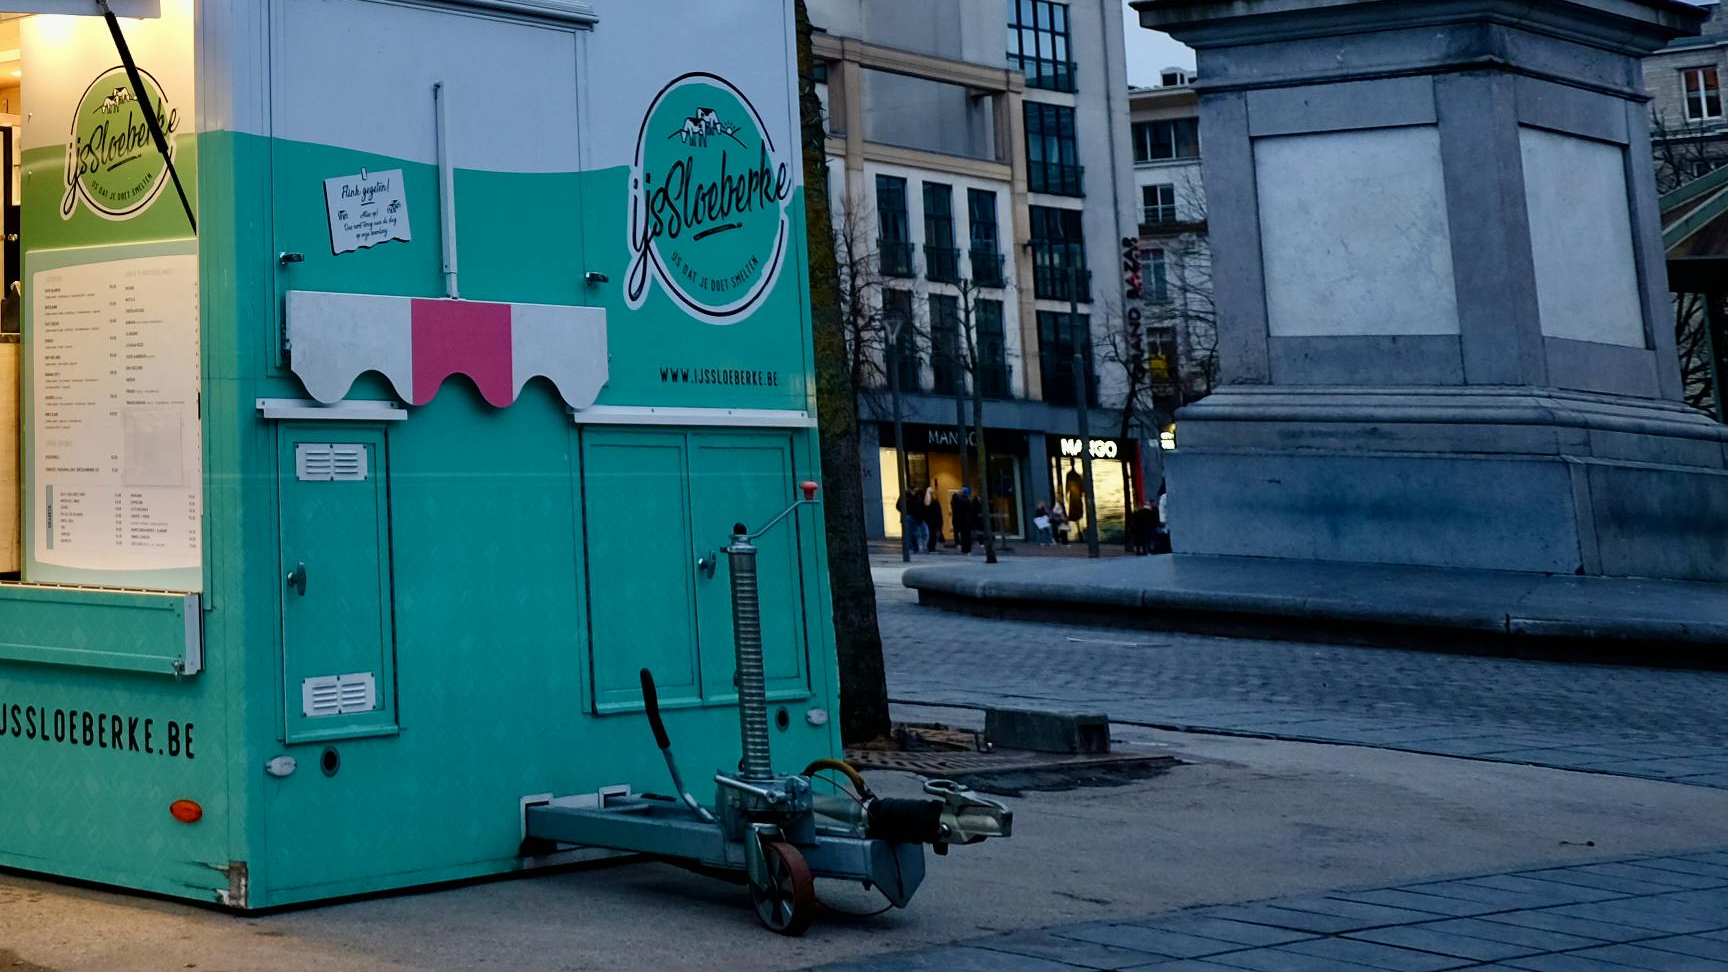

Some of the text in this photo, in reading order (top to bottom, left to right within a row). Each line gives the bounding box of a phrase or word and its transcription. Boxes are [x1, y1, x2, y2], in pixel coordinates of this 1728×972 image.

[682, 263, 697, 283] DAT
[699, 277, 708, 290] JE
[710, 280, 729, 292] DOET
[730, 254, 760, 288] SMELTEN
[659, 366, 779, 387] WWW.IJSSLOEBERKE.BE
